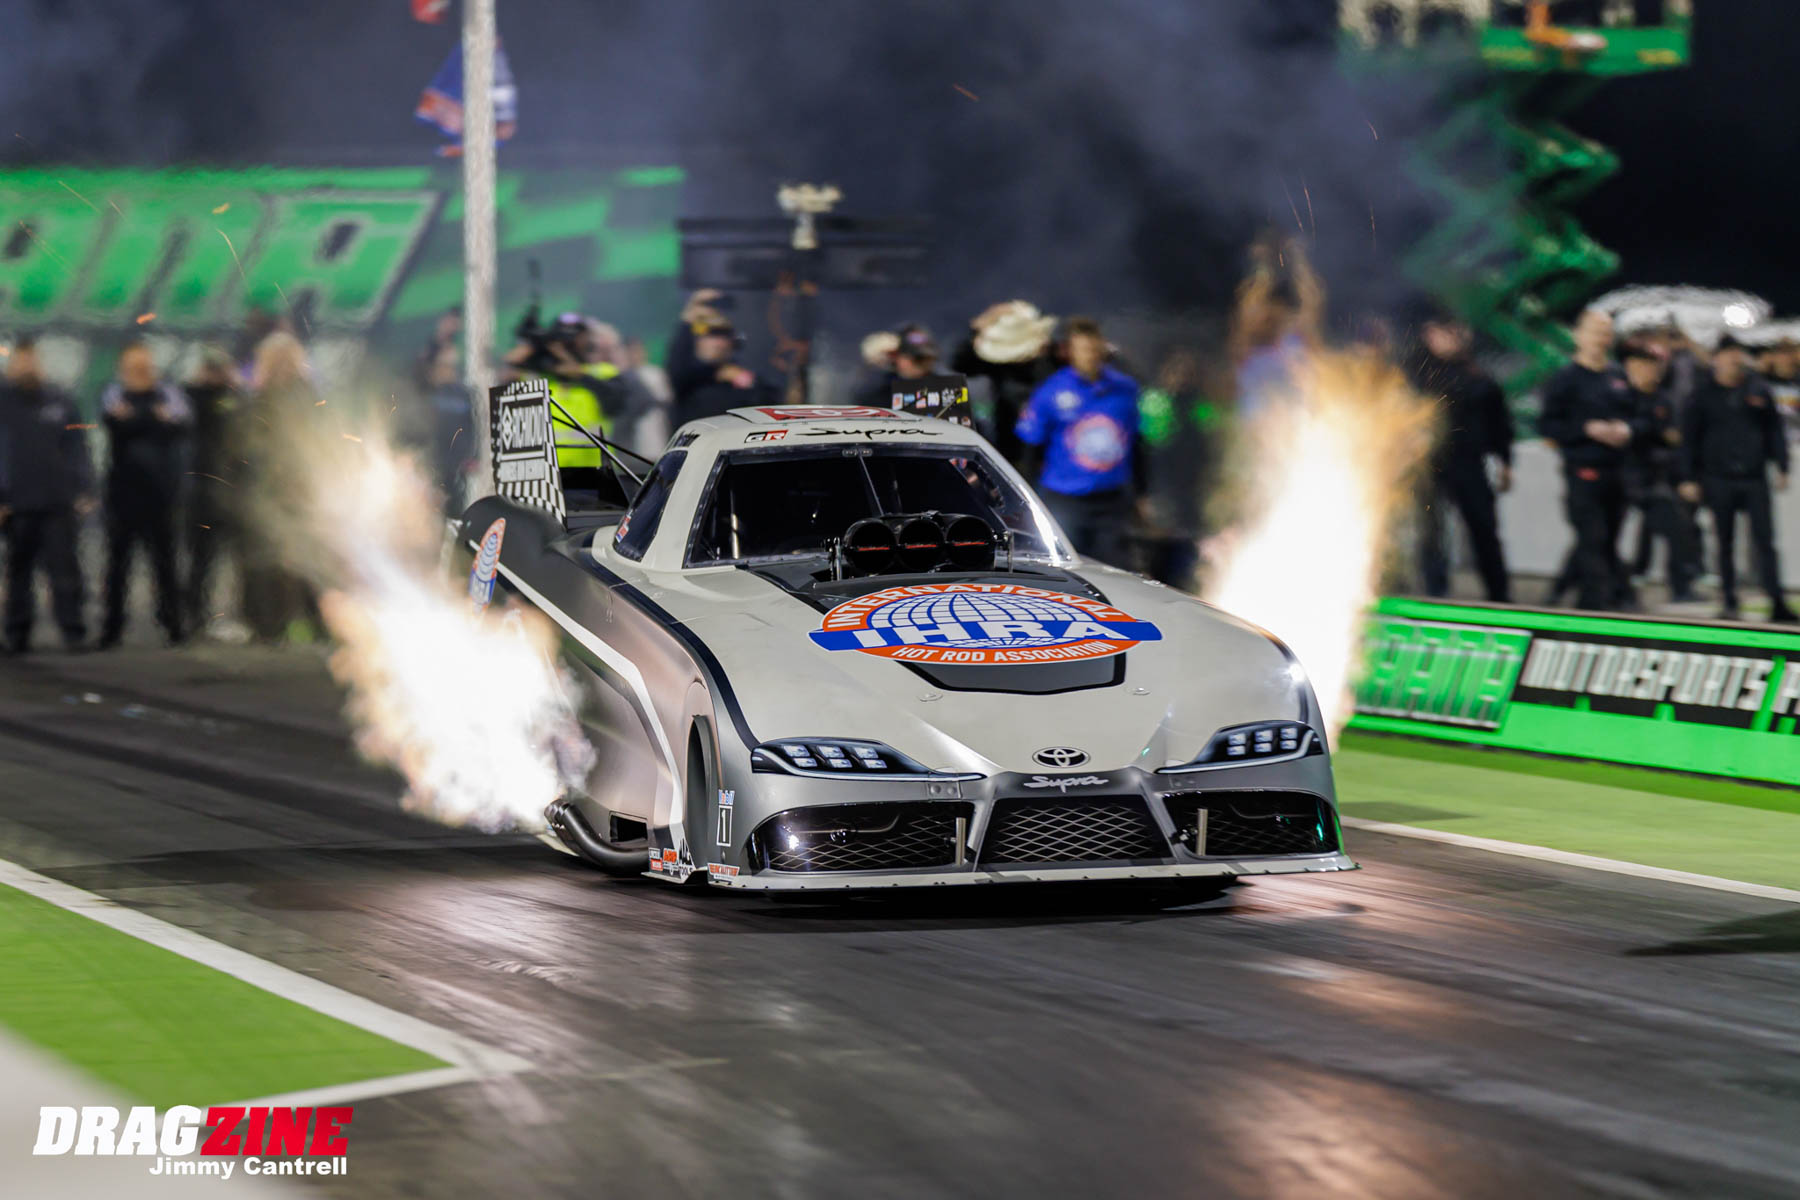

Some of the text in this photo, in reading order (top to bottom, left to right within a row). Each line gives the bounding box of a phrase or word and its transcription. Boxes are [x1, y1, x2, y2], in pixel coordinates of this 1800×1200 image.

[745, 430, 787, 442] GR
[795, 427, 943, 440] Supra
[826, 584, 1125, 629] INTERNATIONAL
[853, 620, 1131, 648] IHRA
[893, 640, 1119, 662] HOT ROD ASSOCIATION
[1519, 637, 1776, 711] MOTORSPORTS
[1023, 775, 1109, 793] Supra
